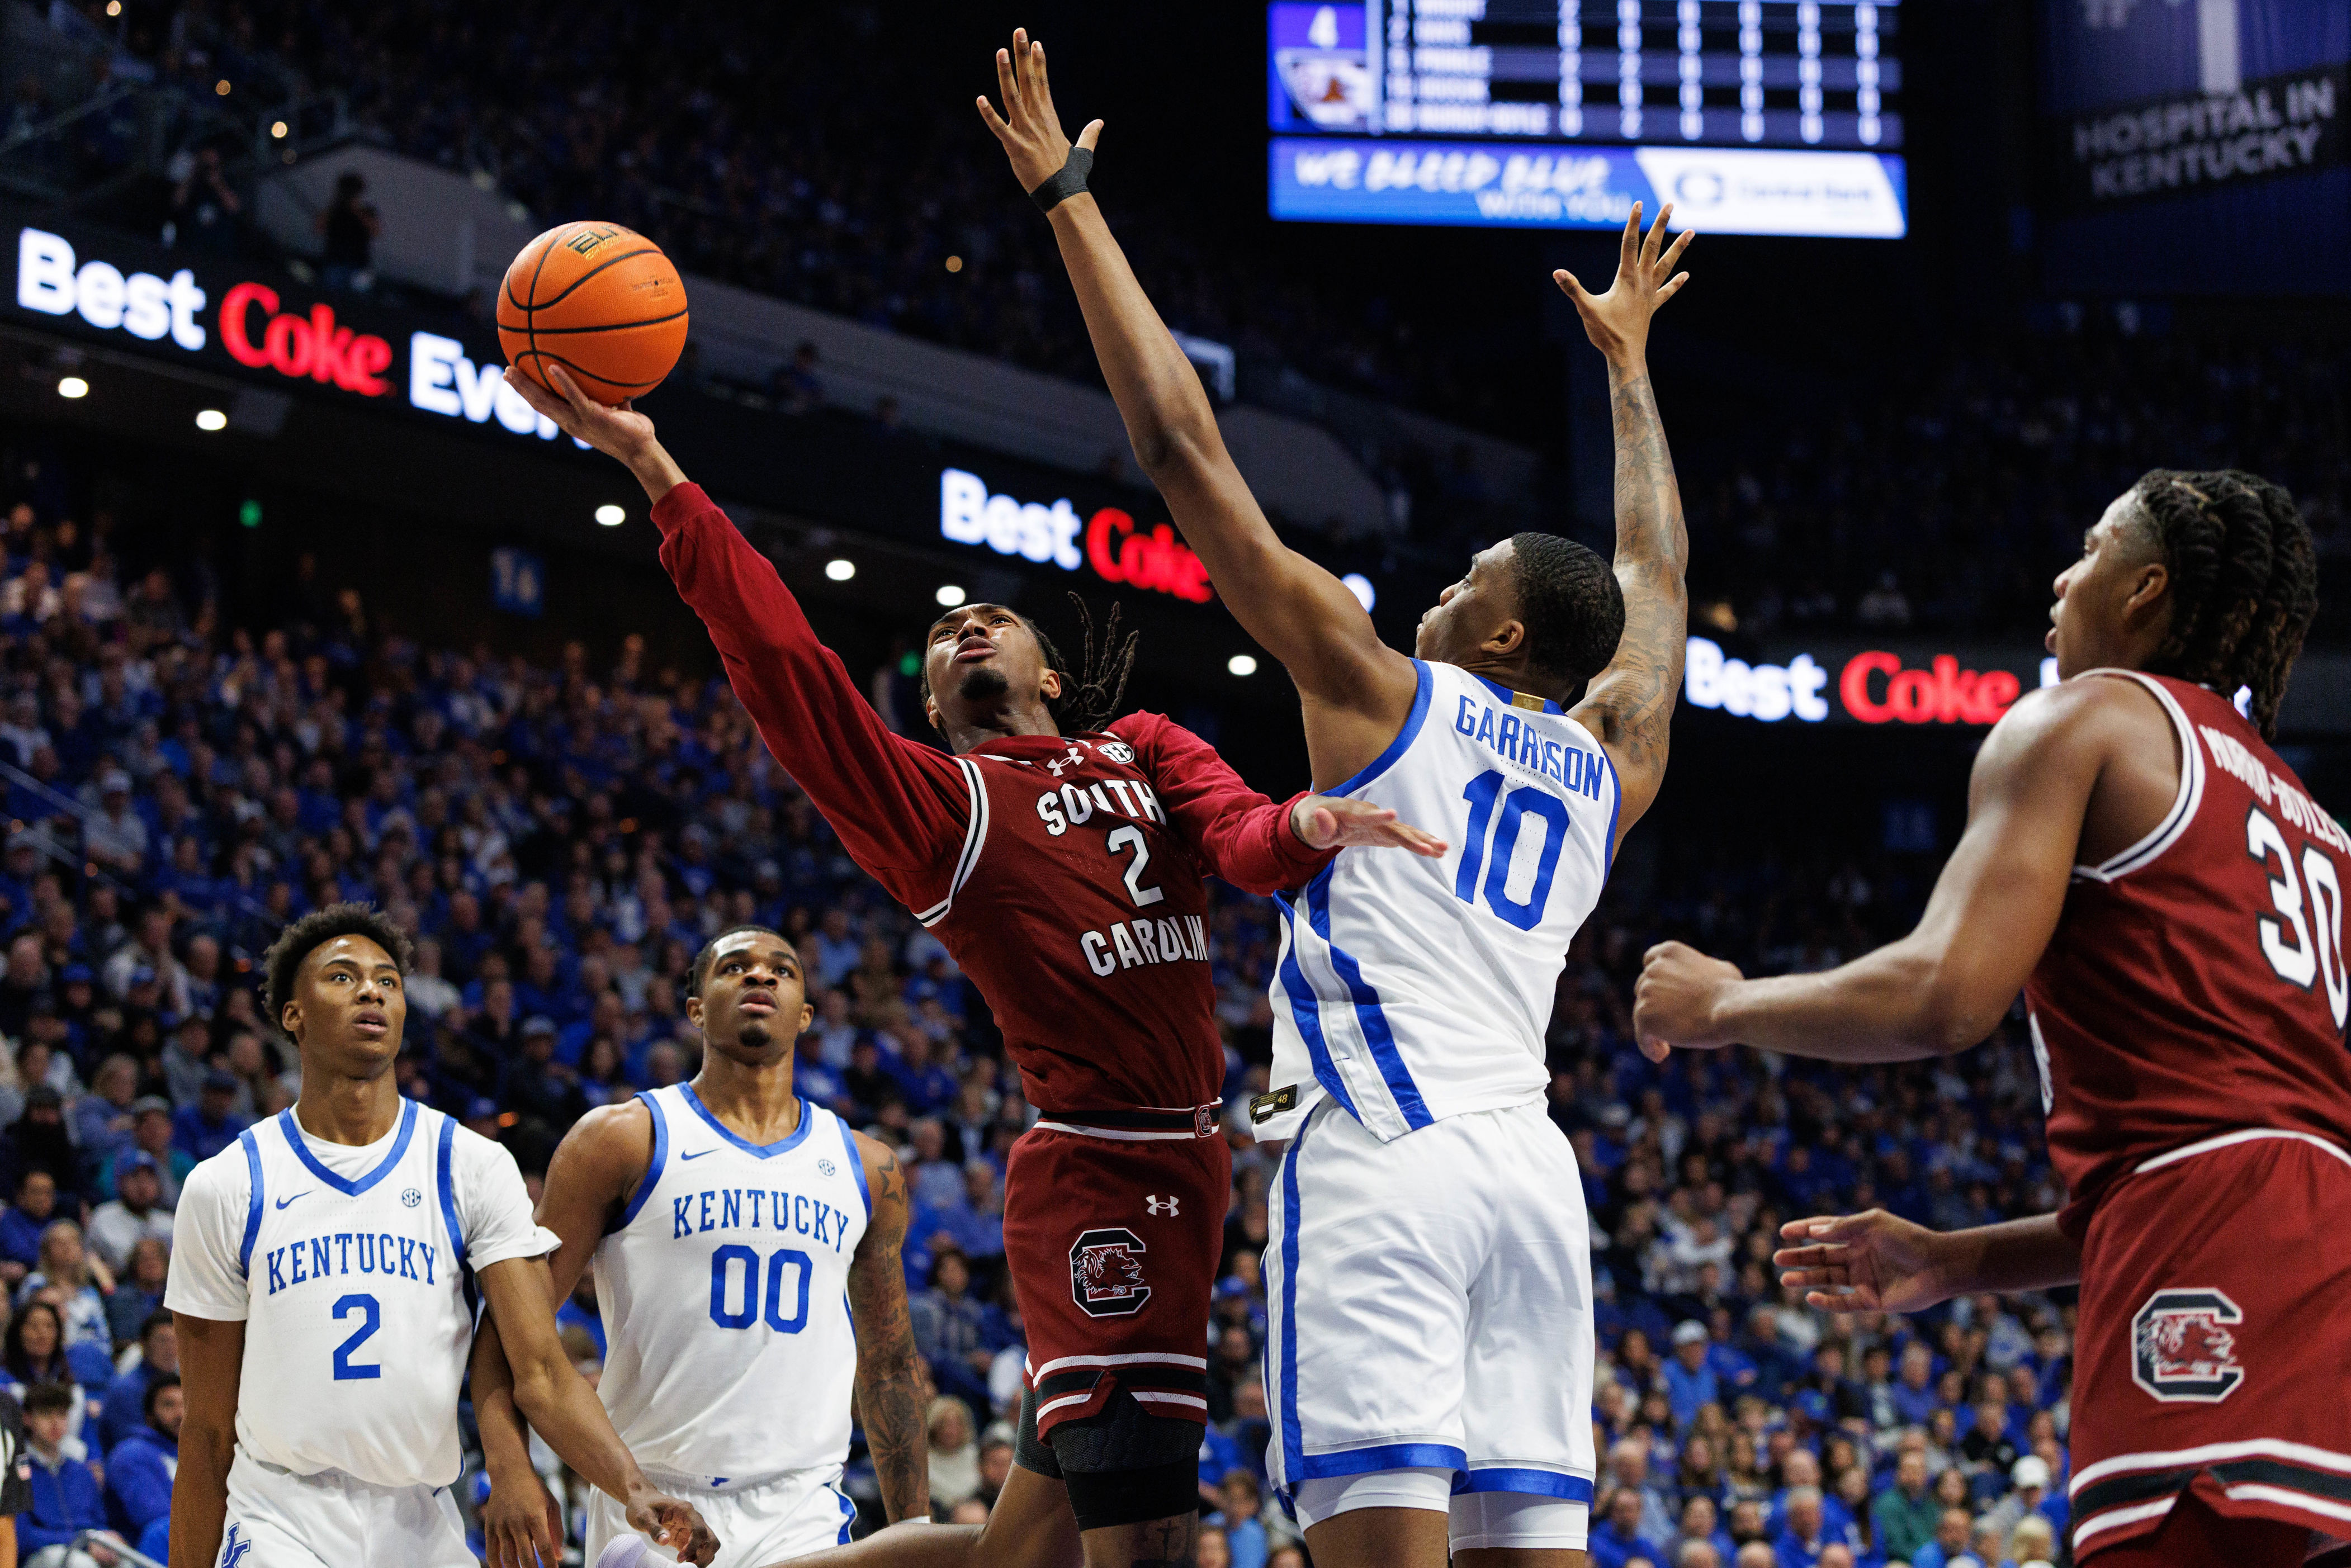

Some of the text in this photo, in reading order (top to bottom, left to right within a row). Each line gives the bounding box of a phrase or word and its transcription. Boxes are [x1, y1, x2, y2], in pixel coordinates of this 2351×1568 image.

[2073, 78, 2335, 161] HOSPITAL IN
[2092, 122, 2321, 197] KENTUCKY
[17, 227, 206, 351] Best
[219, 281, 396, 397] Coke
[941, 467, 1082, 570] Best
[1685, 636, 2020, 726] Best Coke
[1097, 742, 1135, 765] SEC
[1456, 694, 1605, 802] GARRISON
[1036, 779, 1166, 836] SOUTH
[1105, 823, 1164, 907] 2
[1455, 769, 1570, 931] 10
[1080, 915, 1208, 977] CAROLIN
[2245, 800, 2350, 1035] 30
[1277, 1093, 1288, 1103] 48
[401, 1188, 421, 1207] SEC
[818, 1159, 835, 1176] SEC
[673, 1189, 849, 1253] KENTUCKY
[267, 1233, 435, 1296] KENTUCKY
[709, 1244, 813, 1334] 00
[332, 1294, 381, 1381] 2
